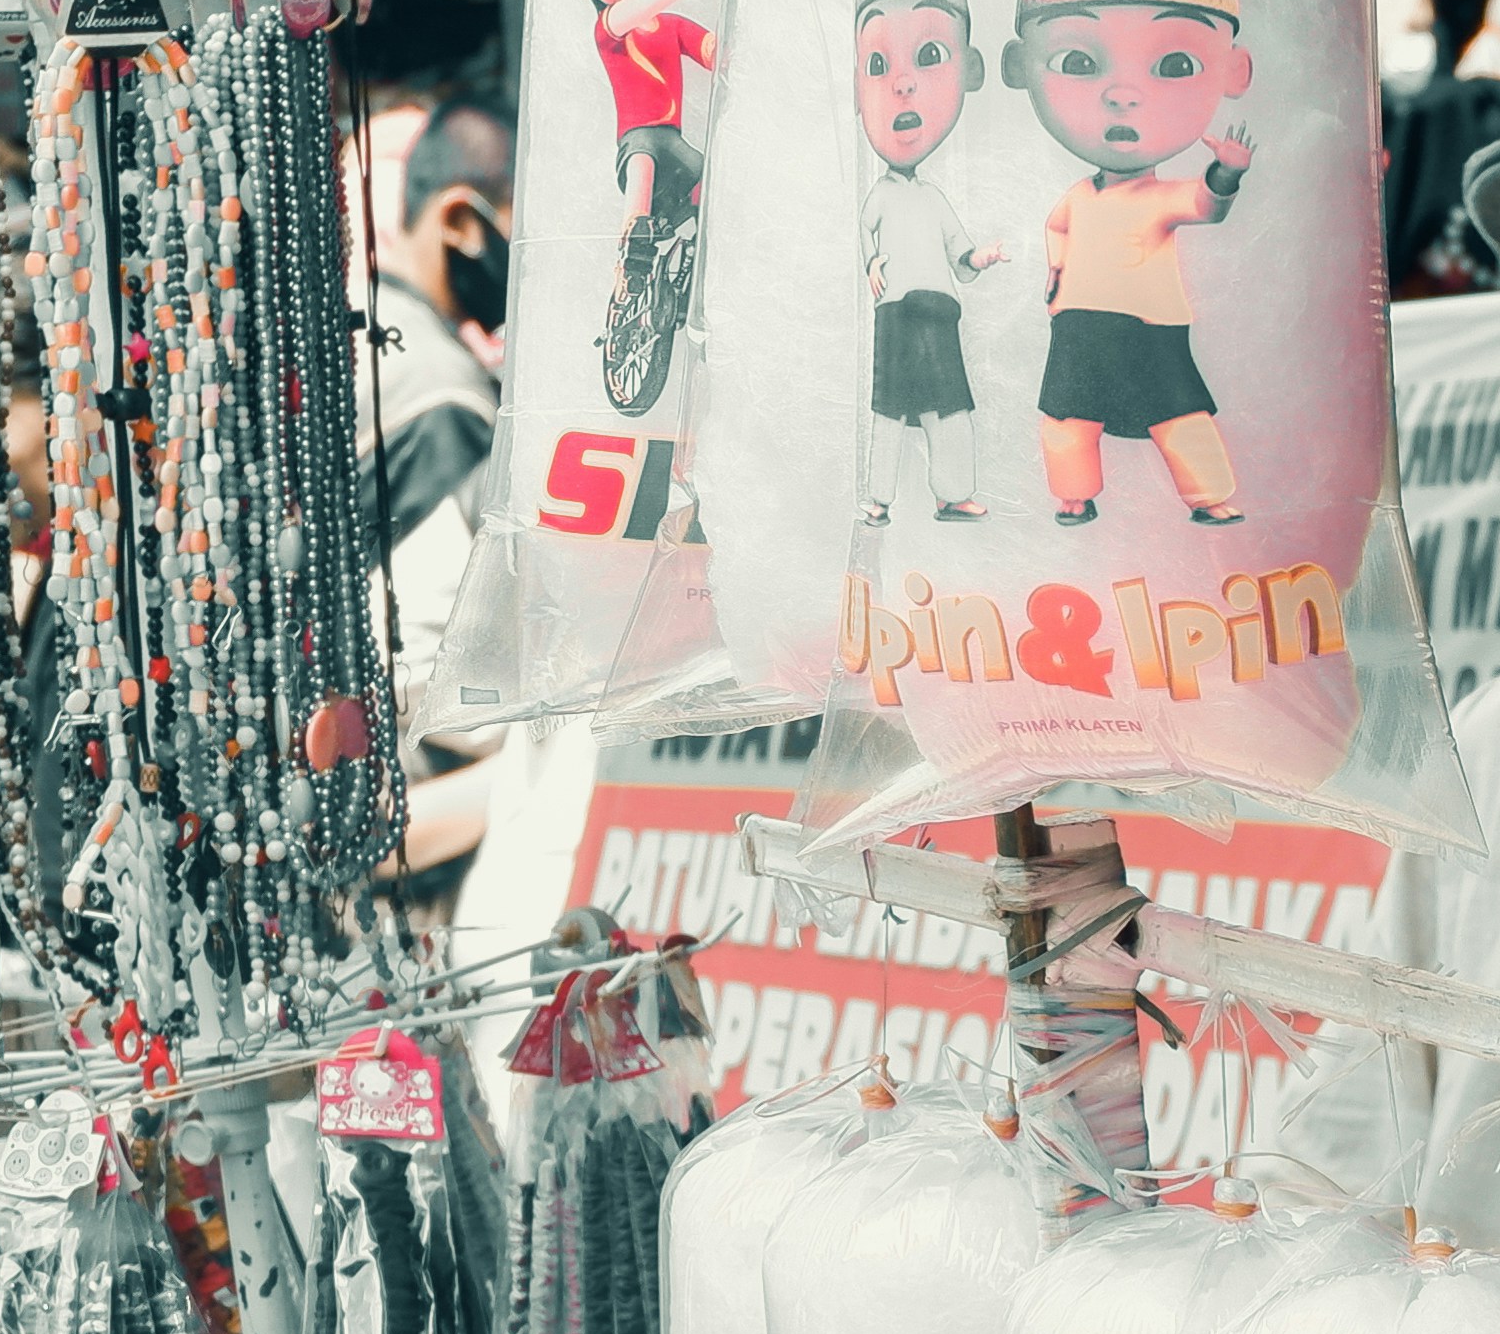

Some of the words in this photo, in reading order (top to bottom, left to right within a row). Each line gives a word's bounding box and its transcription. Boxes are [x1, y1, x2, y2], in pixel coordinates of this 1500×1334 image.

[75, 4, 160, 28] Accessories
[838, 571, 1015, 707] Upin
[1016, 581, 1115, 699] &
[1112, 562, 1346, 702] Ipin
[998, 718, 1062, 734] PRIMA
[1064, 718, 1144, 733] KLATEN
[341, 1096, 414, 1122] Trend
